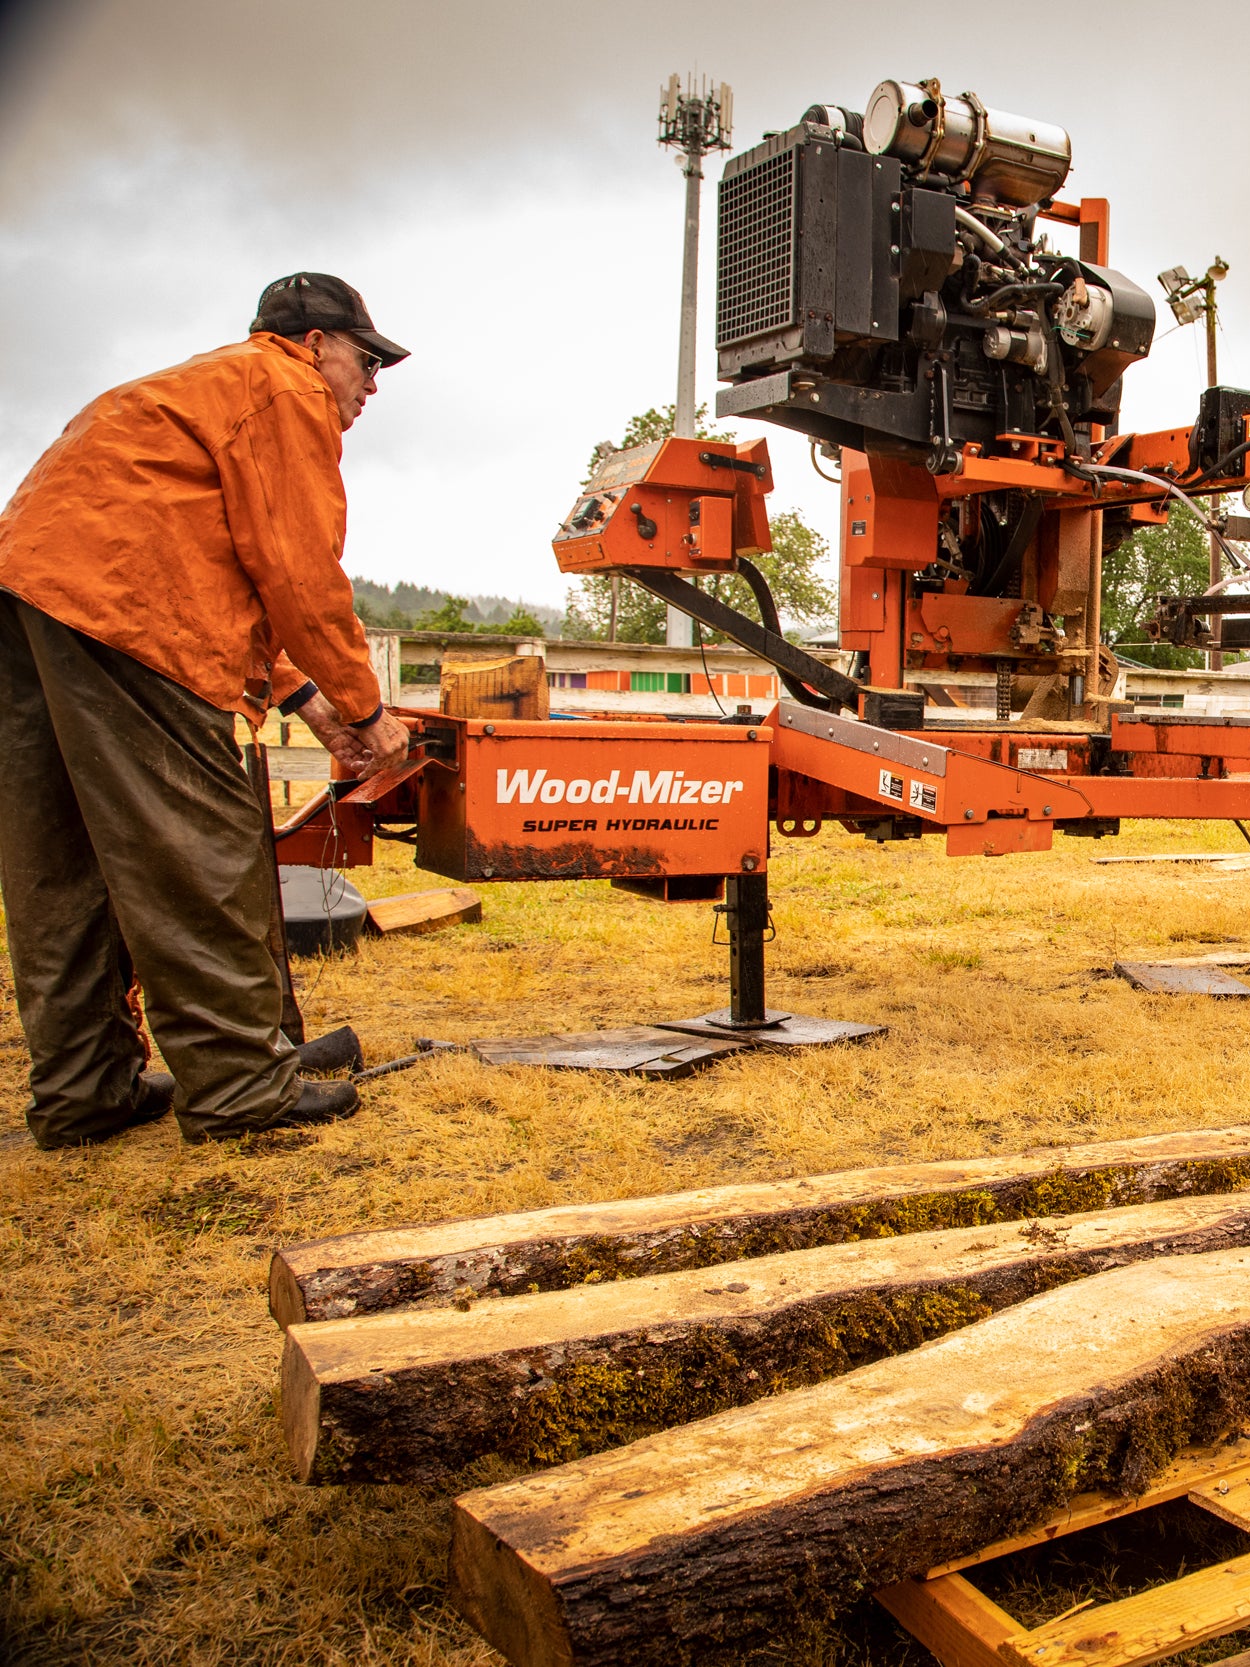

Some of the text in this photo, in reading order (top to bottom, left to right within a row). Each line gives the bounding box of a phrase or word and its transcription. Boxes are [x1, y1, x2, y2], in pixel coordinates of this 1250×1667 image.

[496, 769, 744, 804] Wood-Mizer
[522, 819, 719, 832] SUPER HYDRAULIC
